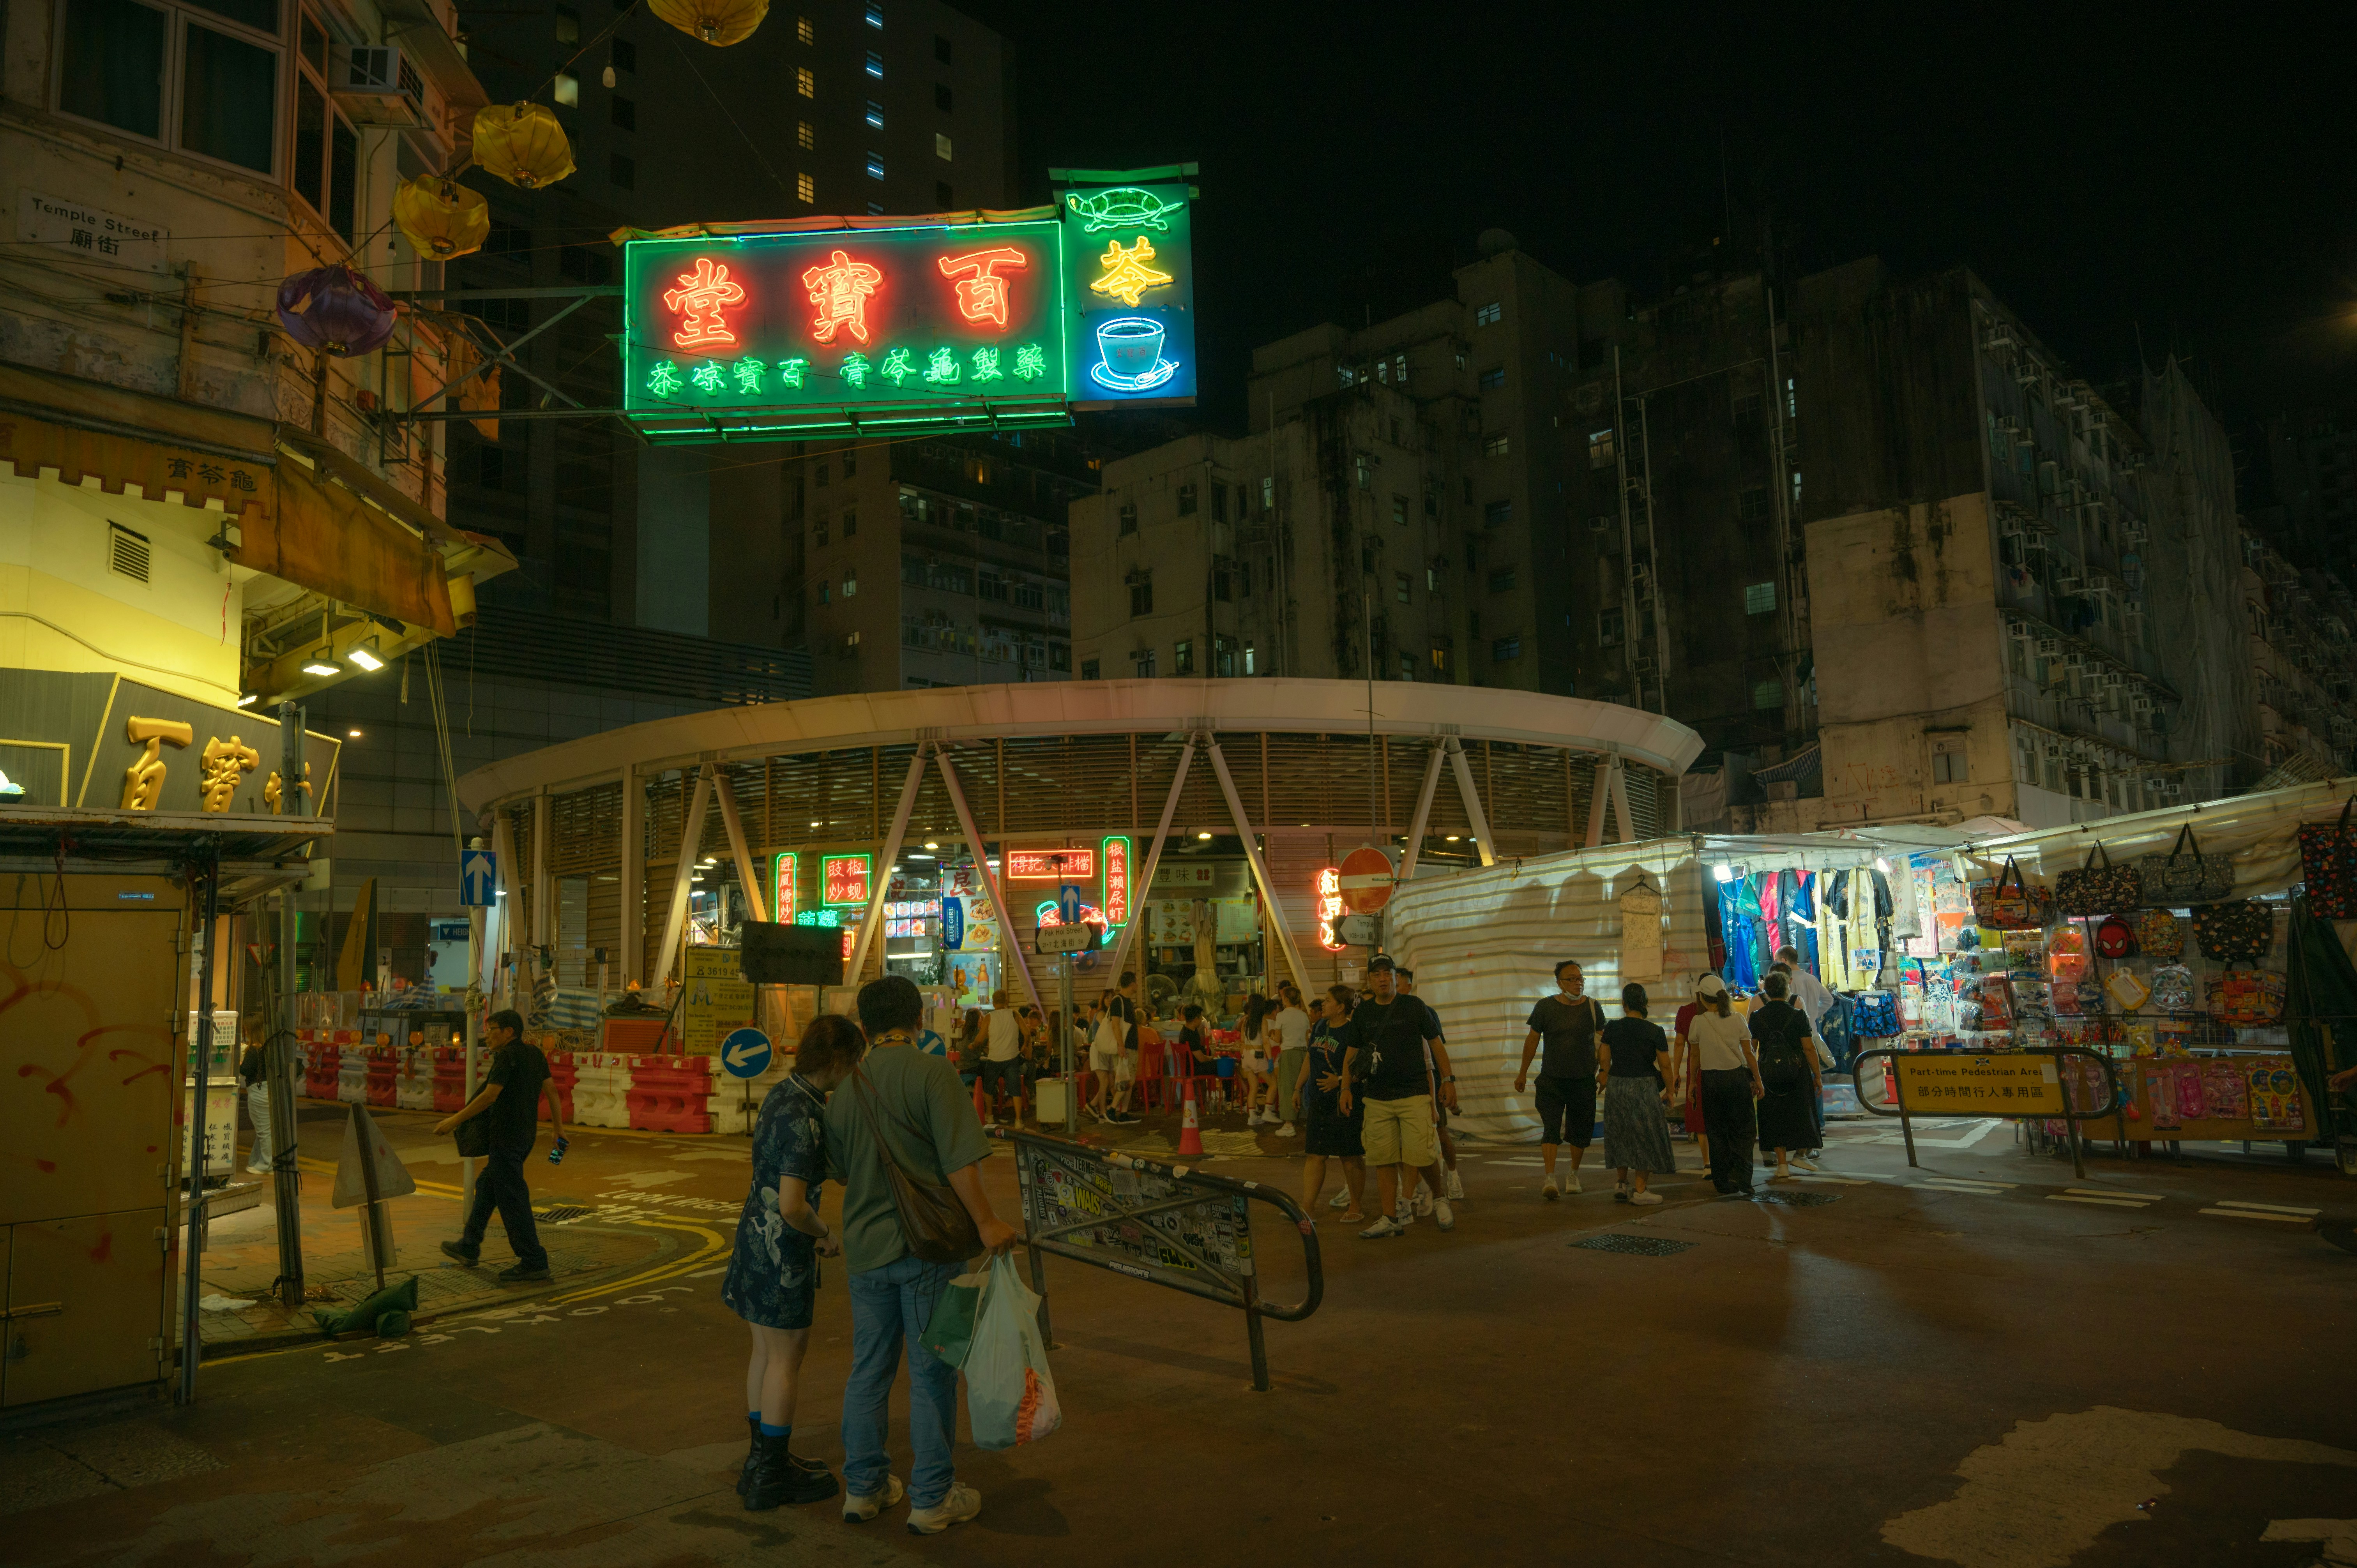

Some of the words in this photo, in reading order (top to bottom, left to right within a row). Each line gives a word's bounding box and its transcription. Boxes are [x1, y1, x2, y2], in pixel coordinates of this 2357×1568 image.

[32, 197, 96, 225] Temple
[104, 218, 159, 242] Street
[69, 228, 119, 256] 廟街
[1089, 235, 1175, 308] 苓
[1012, 855, 1090, 872] 得記排檔
[949, 867, 975, 897] 良
[1357, 920, 1374, 928] Temple
[1053, 938, 1074, 948] 北海街
[707, 967, 728, 976] 3619
[1909, 1068, 1957, 1076] Part-time
[1961, 1068, 2016, 1076] Pedestrian
[1918, 1086, 2044, 1098] 部分時間行人專用區
[1109, 1261, 1150, 1278] FIGUEROA'S
